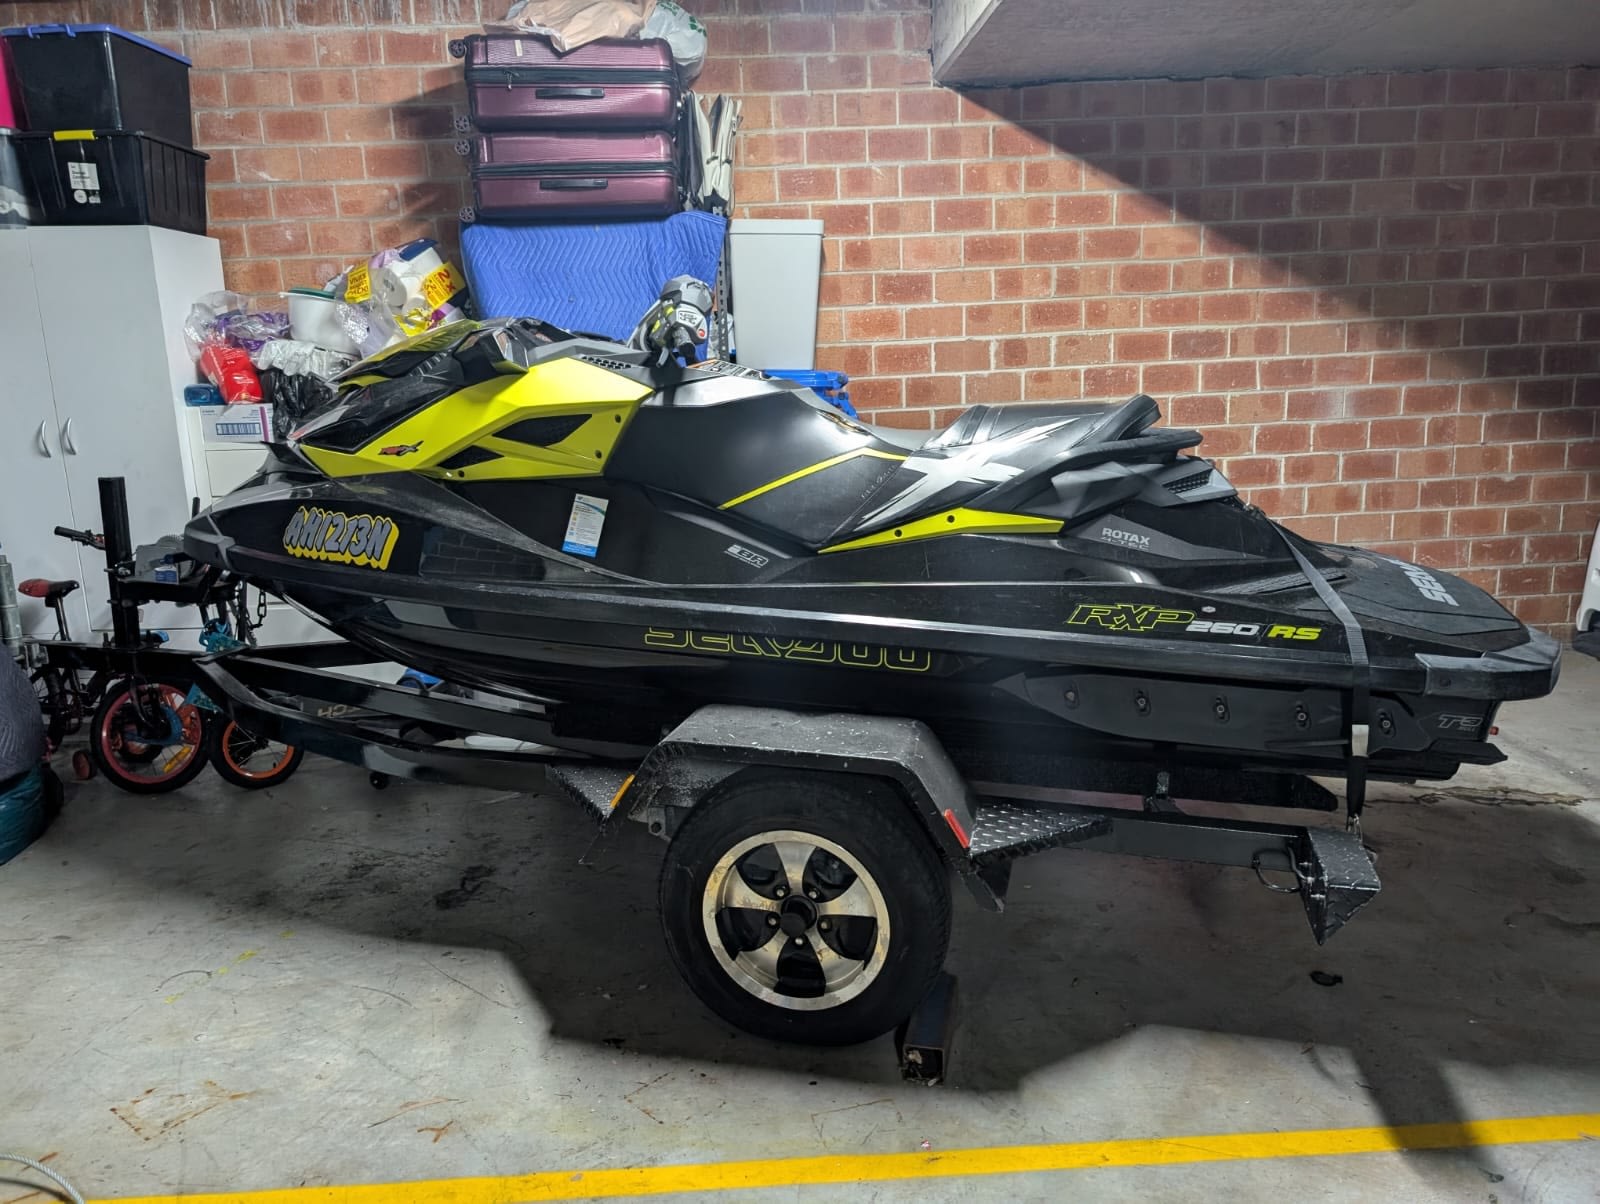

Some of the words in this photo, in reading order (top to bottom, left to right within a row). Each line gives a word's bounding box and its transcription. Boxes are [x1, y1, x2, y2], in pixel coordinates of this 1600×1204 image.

[1102, 527, 1151, 546] ROTAX
[1067, 604, 1196, 631] RXP
[1185, 620, 1260, 636] 260
[1267, 625, 1322, 640] RS
